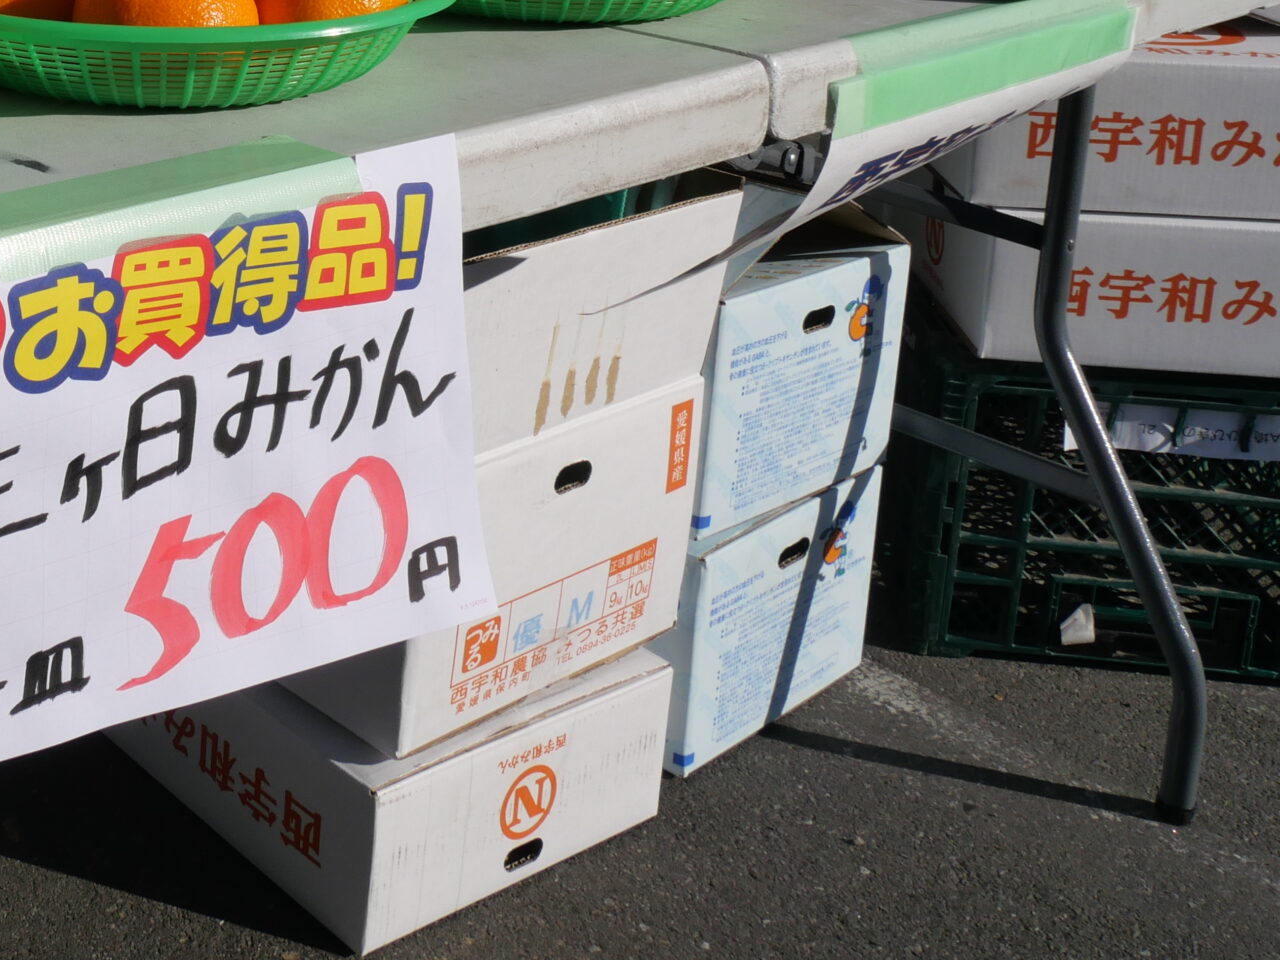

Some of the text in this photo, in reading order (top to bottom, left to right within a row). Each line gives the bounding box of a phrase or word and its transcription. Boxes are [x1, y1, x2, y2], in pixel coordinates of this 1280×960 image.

[1026, 111, 1280, 167] 西宇和み
[567, 591, 594, 629] M
[512, 613, 544, 653] 優
[451, 647, 547, 704] 西宇和農協
[556, 653, 573, 665] TEL
